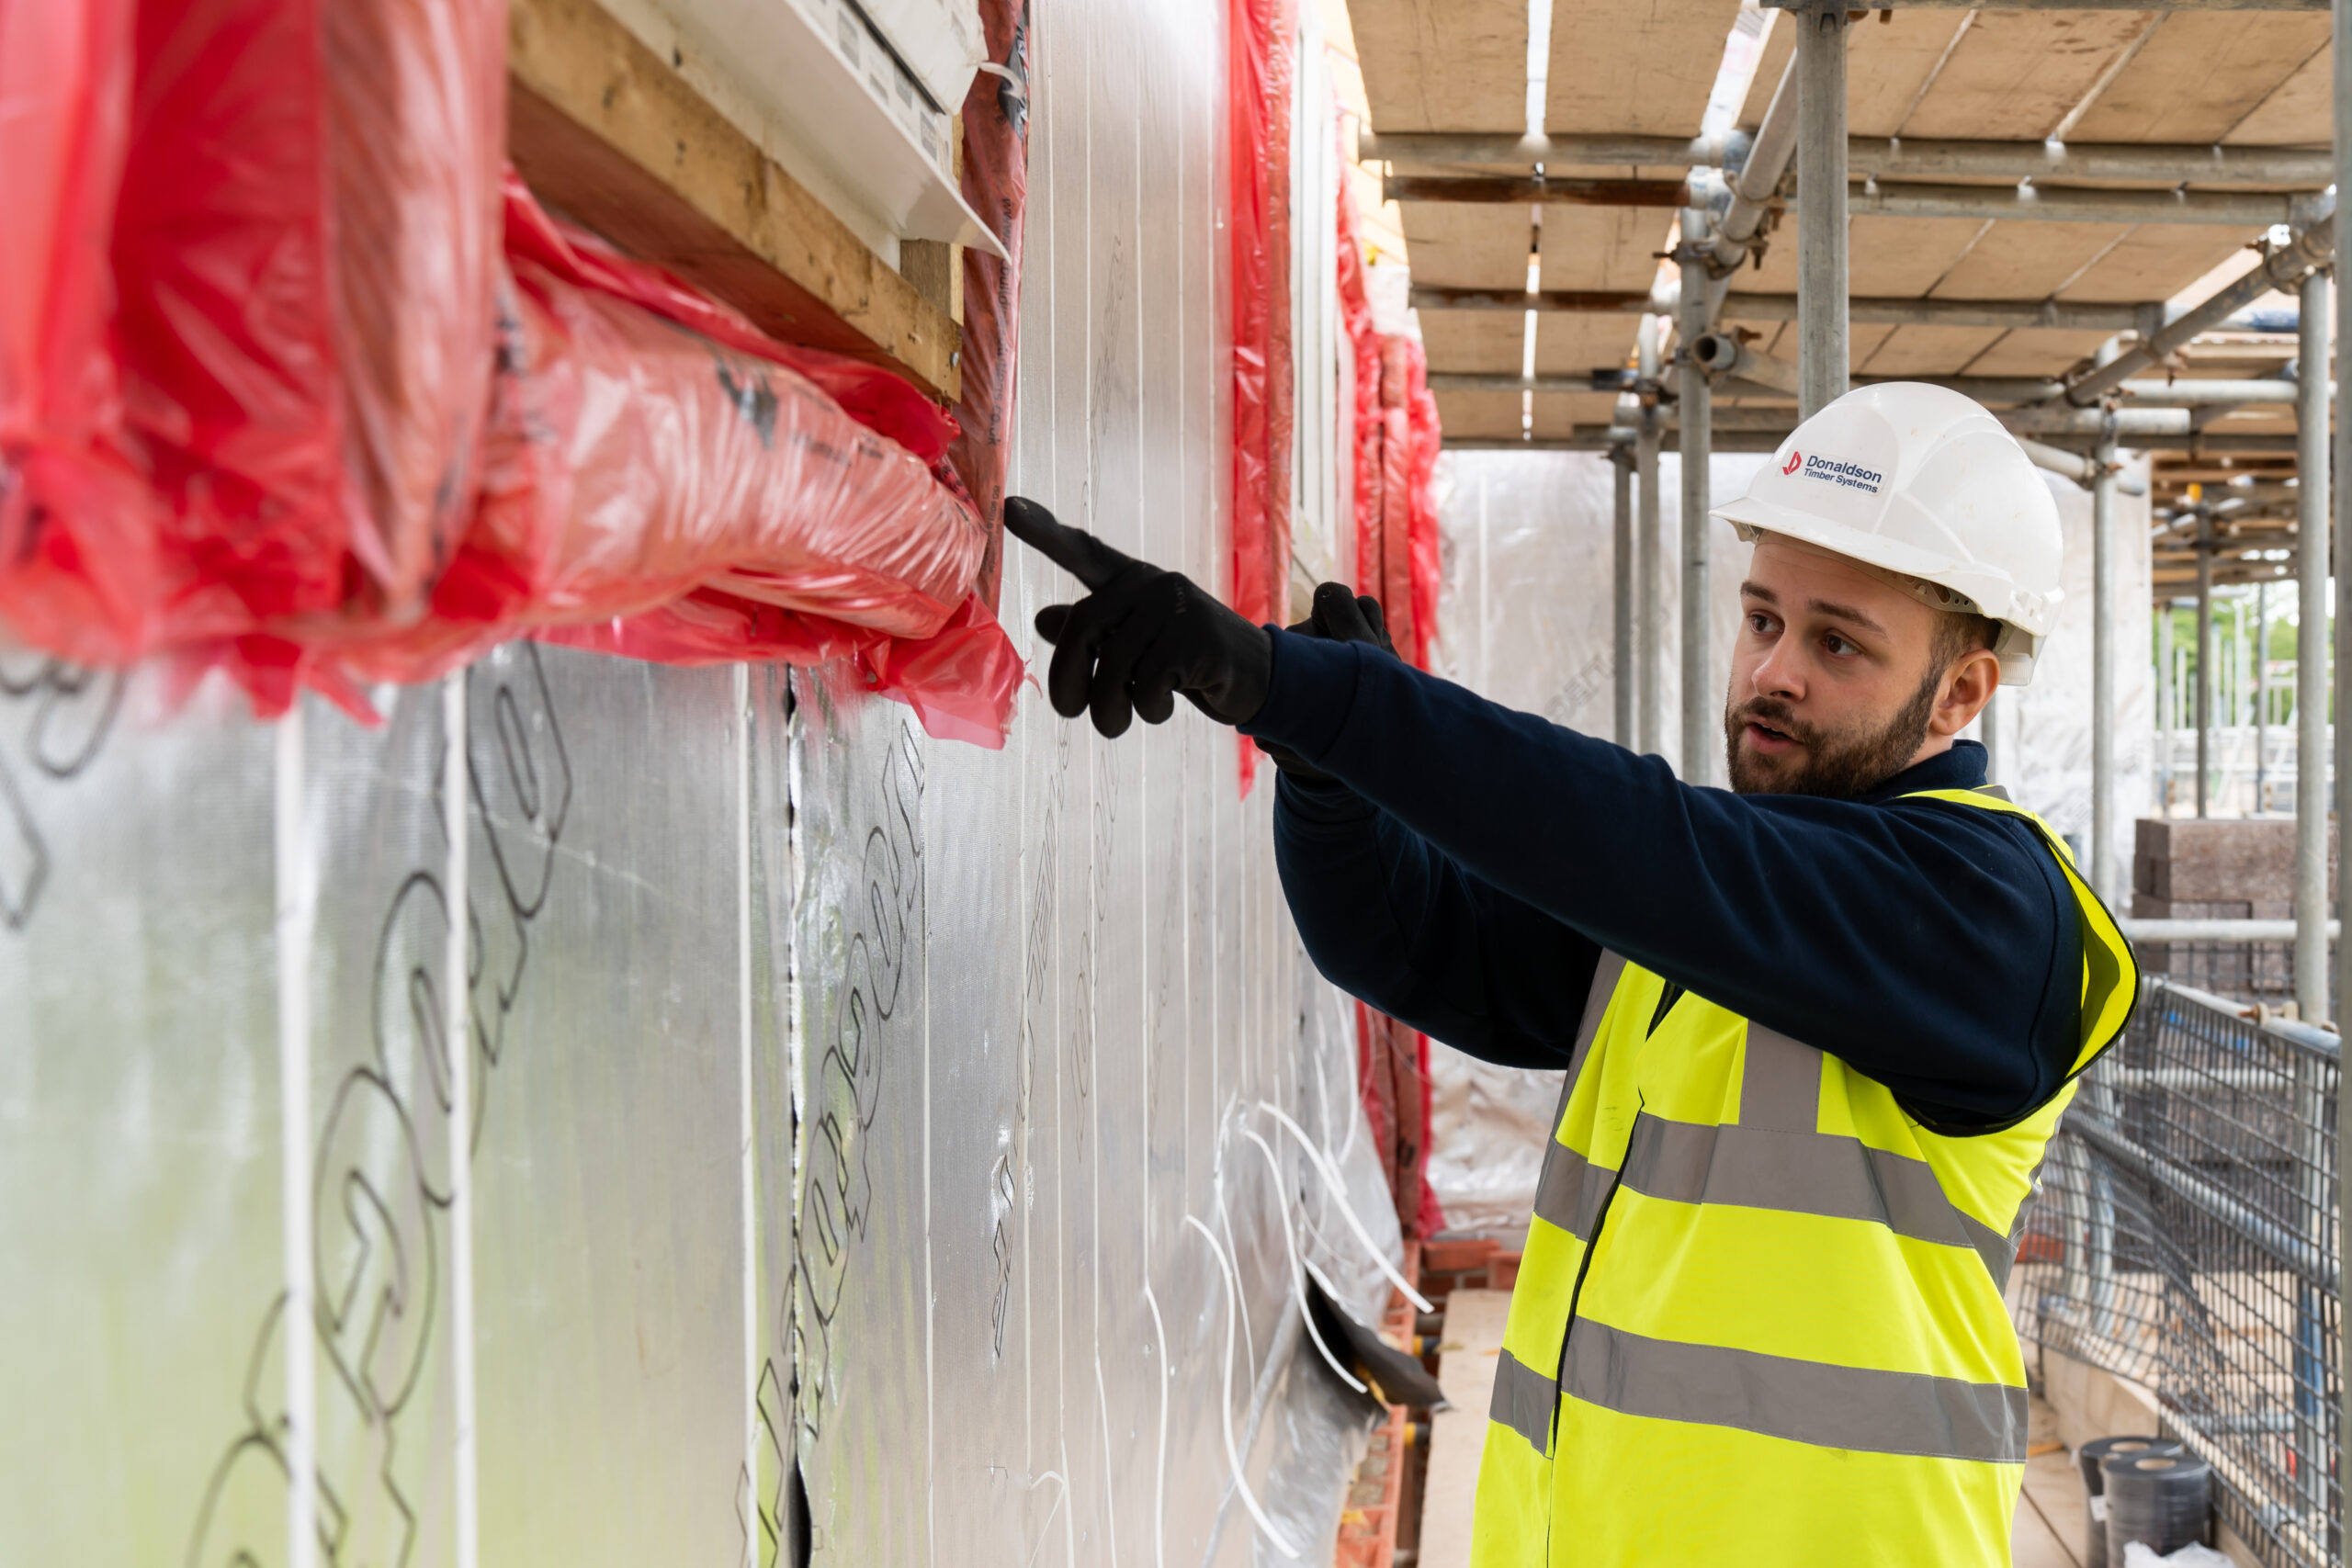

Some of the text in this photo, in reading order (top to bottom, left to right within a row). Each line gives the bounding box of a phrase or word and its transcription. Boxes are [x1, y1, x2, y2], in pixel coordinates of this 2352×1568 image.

[1804, 468, 1878, 493] Timber Systems
[1806, 456, 1882, 482] Donaldson
